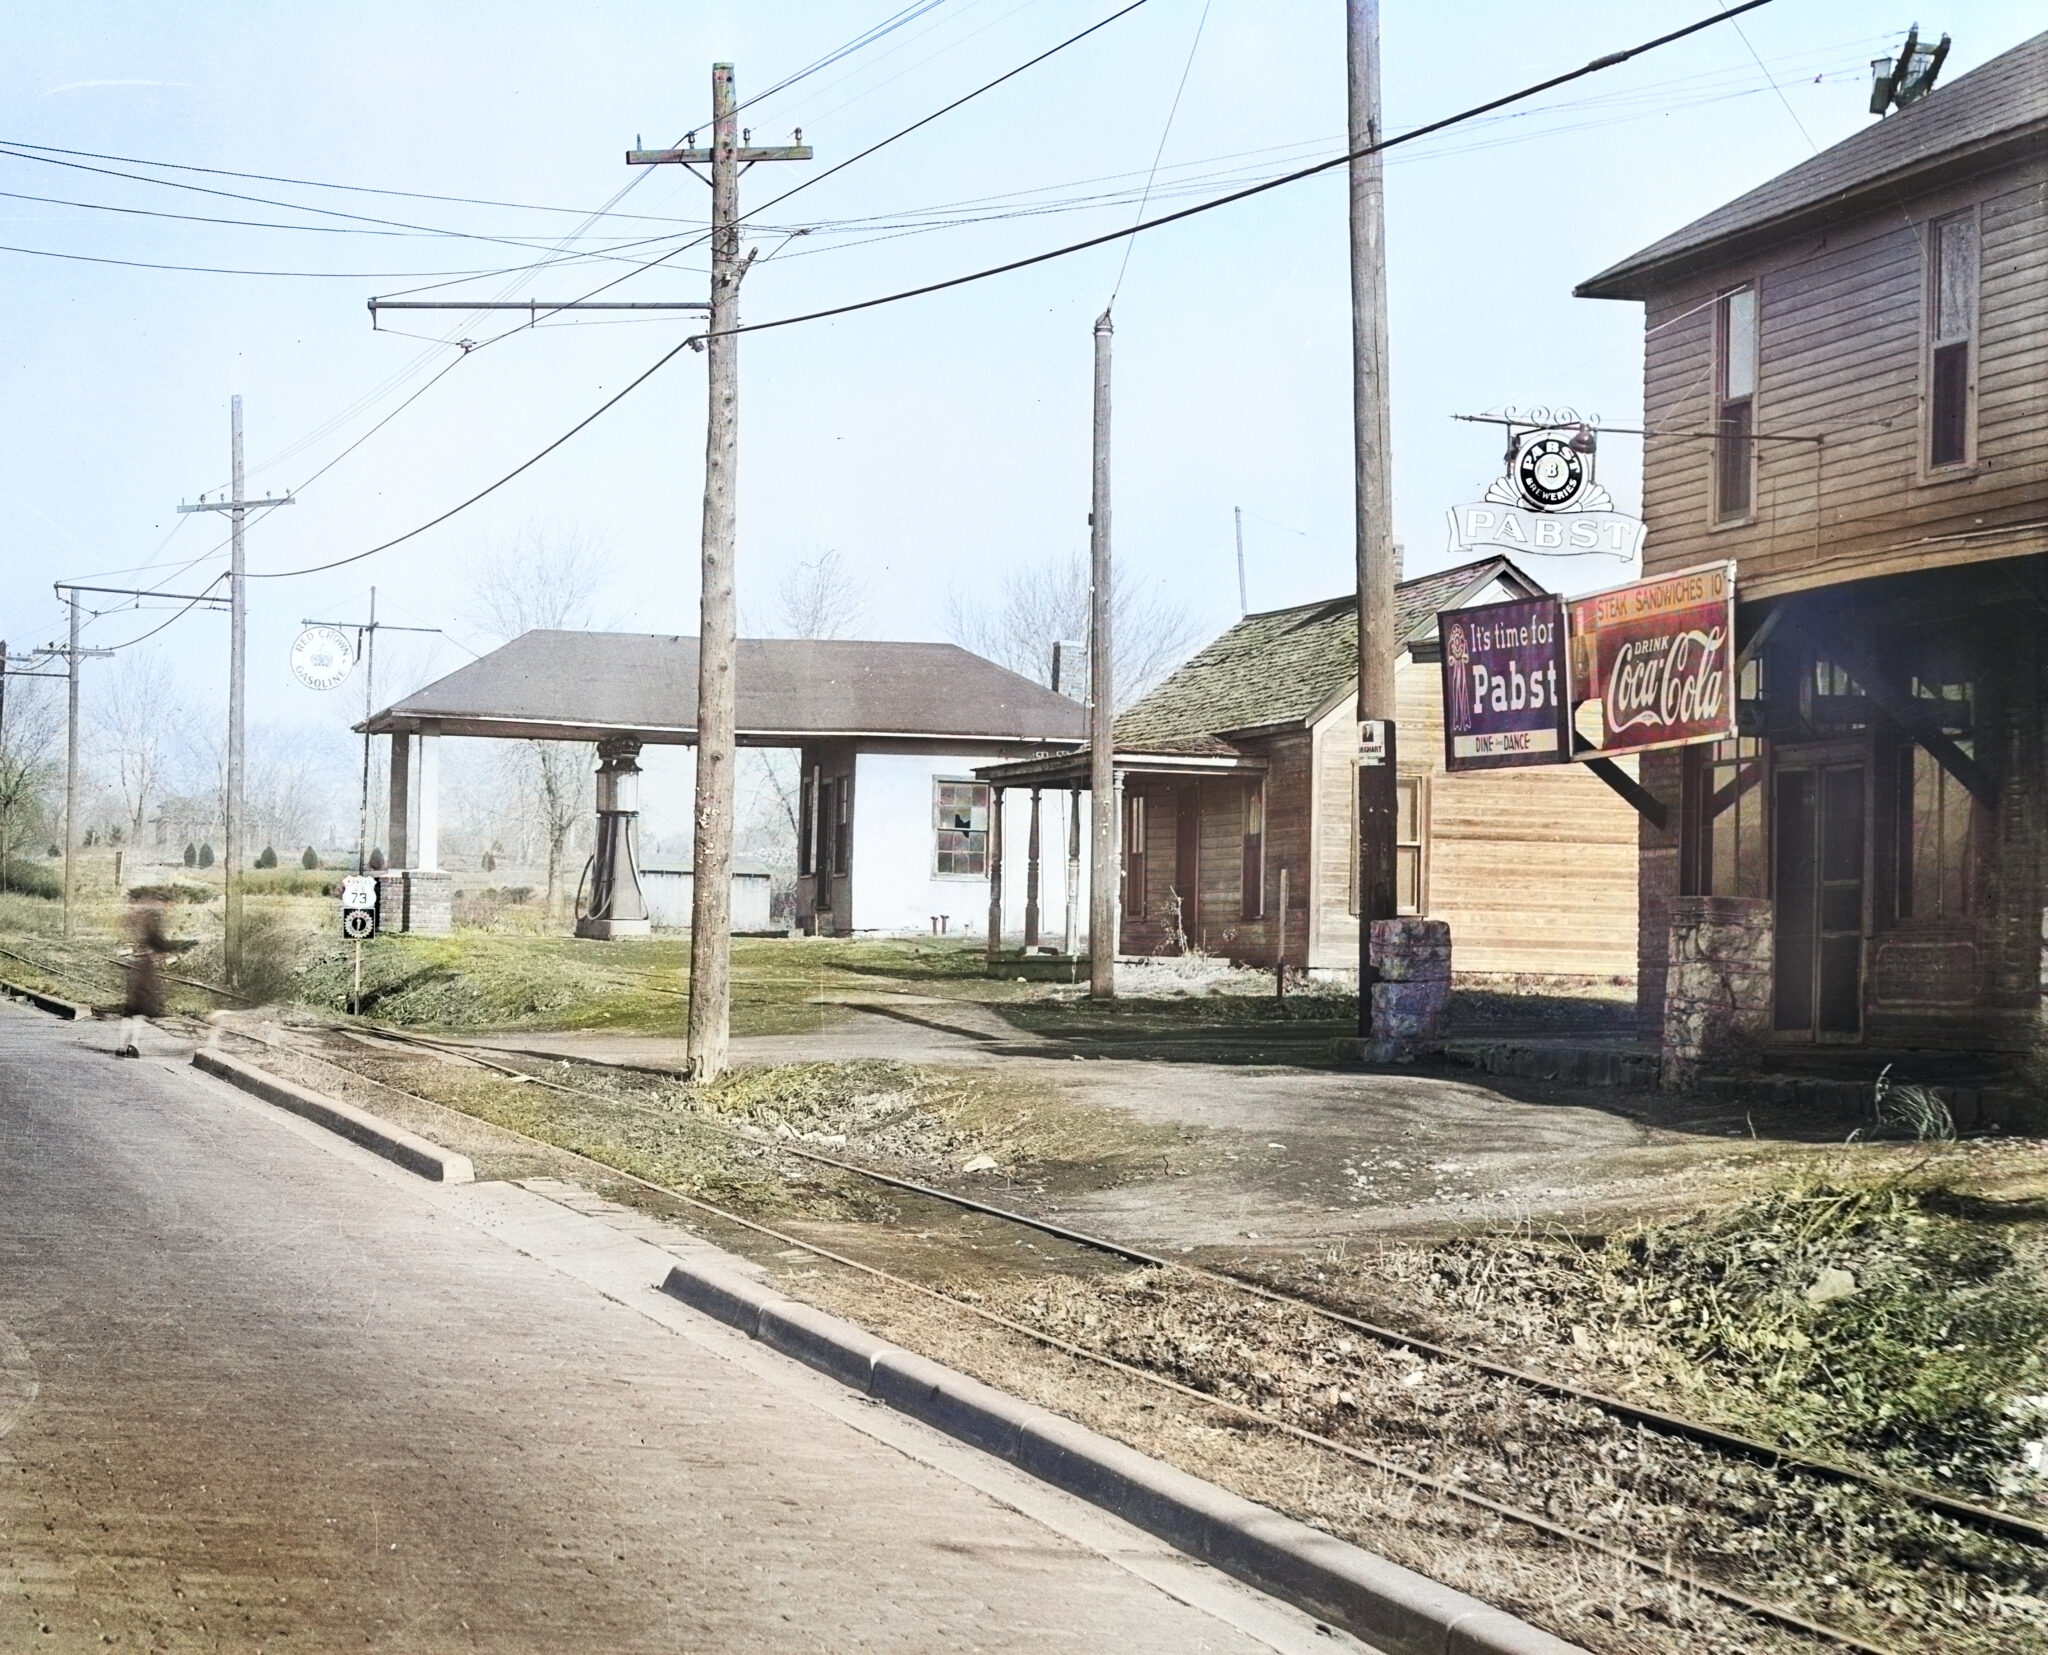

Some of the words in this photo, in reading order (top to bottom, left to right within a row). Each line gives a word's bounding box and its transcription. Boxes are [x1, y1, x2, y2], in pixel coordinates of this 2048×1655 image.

[1523, 441, 1580, 474] PABST
[1525, 477, 1578, 501] BREWERIES
[1466, 510, 1631, 549] PABST
[1597, 595, 1628, 620] STEAK
[1635, 578, 1703, 612] SANDWICHES
[295, 632, 314, 653] RED
[1470, 623, 1491, 652] It's
[1495, 621, 1528, 649] time
[1531, 614, 1554, 644] for
[1634, 635, 1670, 655] DRINK
[296, 665, 347, 688] GASOLINE
[1472, 660, 1558, 714] Pabst
[1607, 626, 1727, 733] Coca-Cola
[1475, 736, 1494, 752] DINE
[1503, 733, 1531, 750] DANCE
[351, 892, 367, 904] 73
